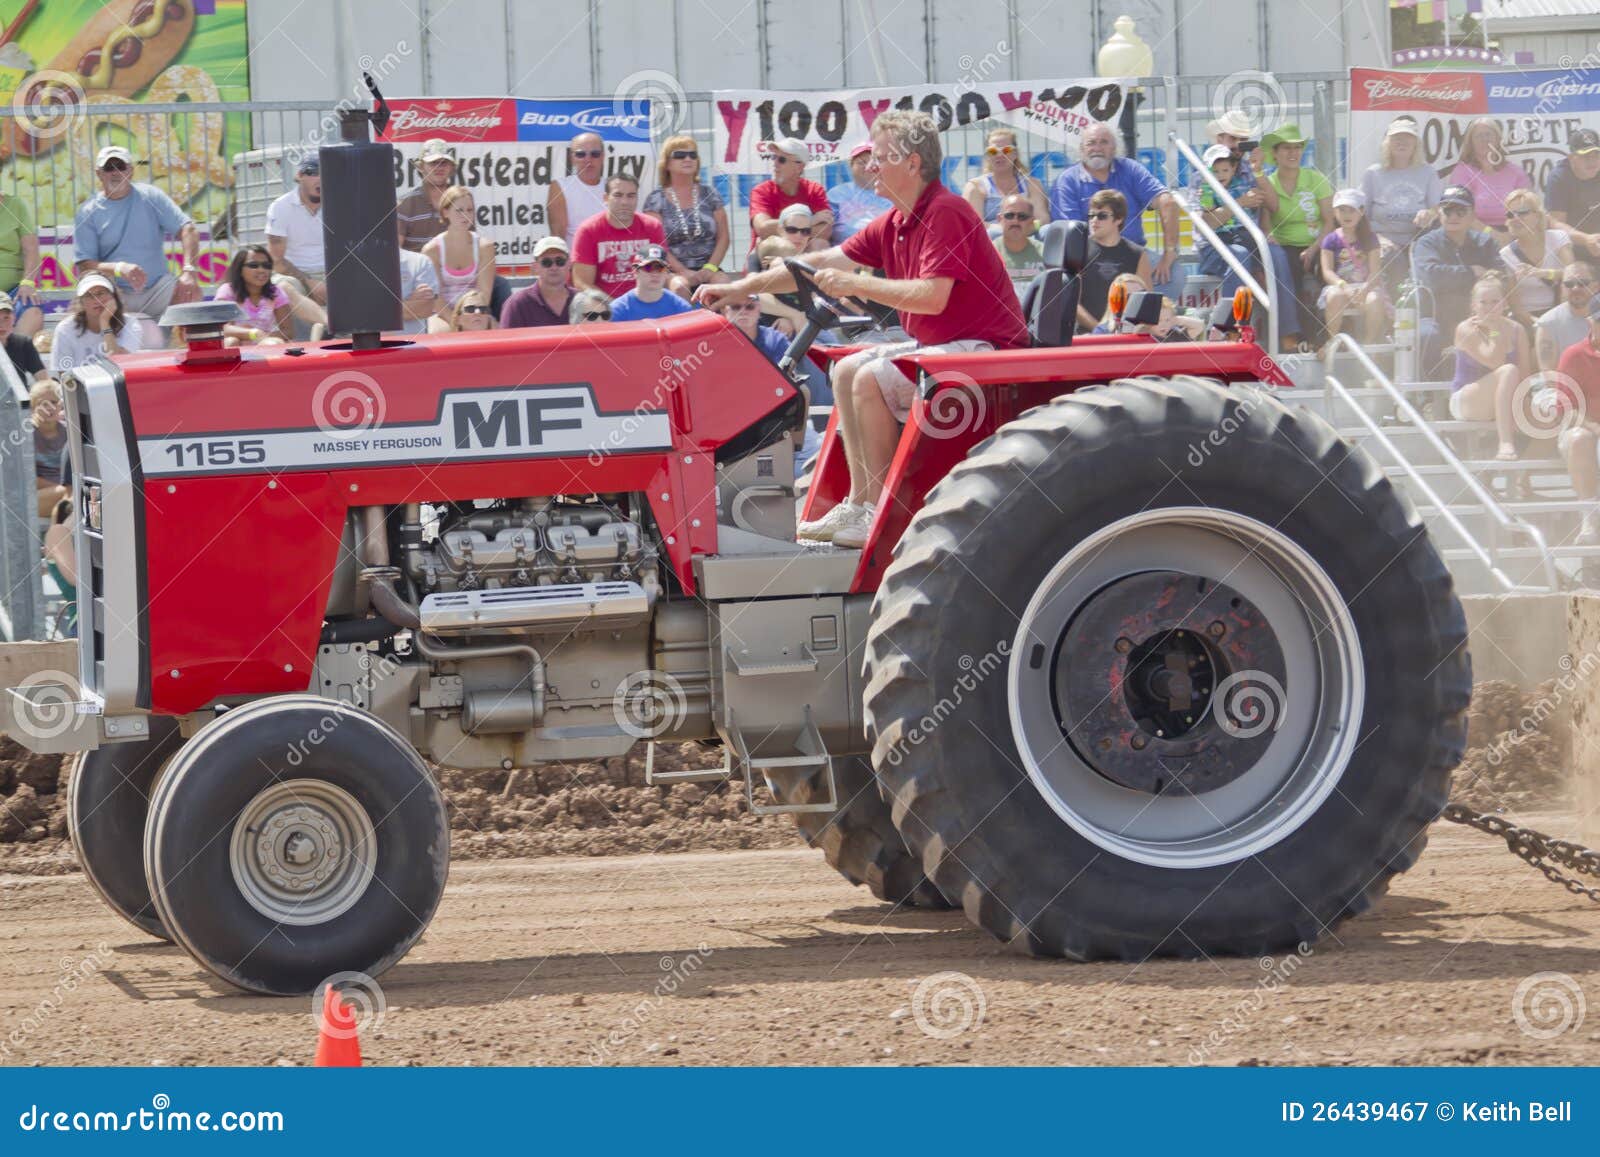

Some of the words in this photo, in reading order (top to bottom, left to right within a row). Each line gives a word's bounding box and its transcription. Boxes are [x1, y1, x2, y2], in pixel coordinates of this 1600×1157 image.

[1363, 79, 1473, 101] Budweiser
[1489, 86, 1534, 98] BUD
[389, 109, 502, 130] Budweiser
[520, 113, 570, 126] BUD
[579, 113, 648, 127] LIGHT
[716, 100, 848, 163] Y100
[1422, 117, 1583, 164] OMLETE
[756, 142, 840, 153] CTRY
[393, 146, 552, 188] Brkstead
[453, 396, 584, 450] MF
[165, 440, 266, 467] 1155
[313, 440, 370, 453] MASSEY
[372, 436, 442, 450] FERGUSON
